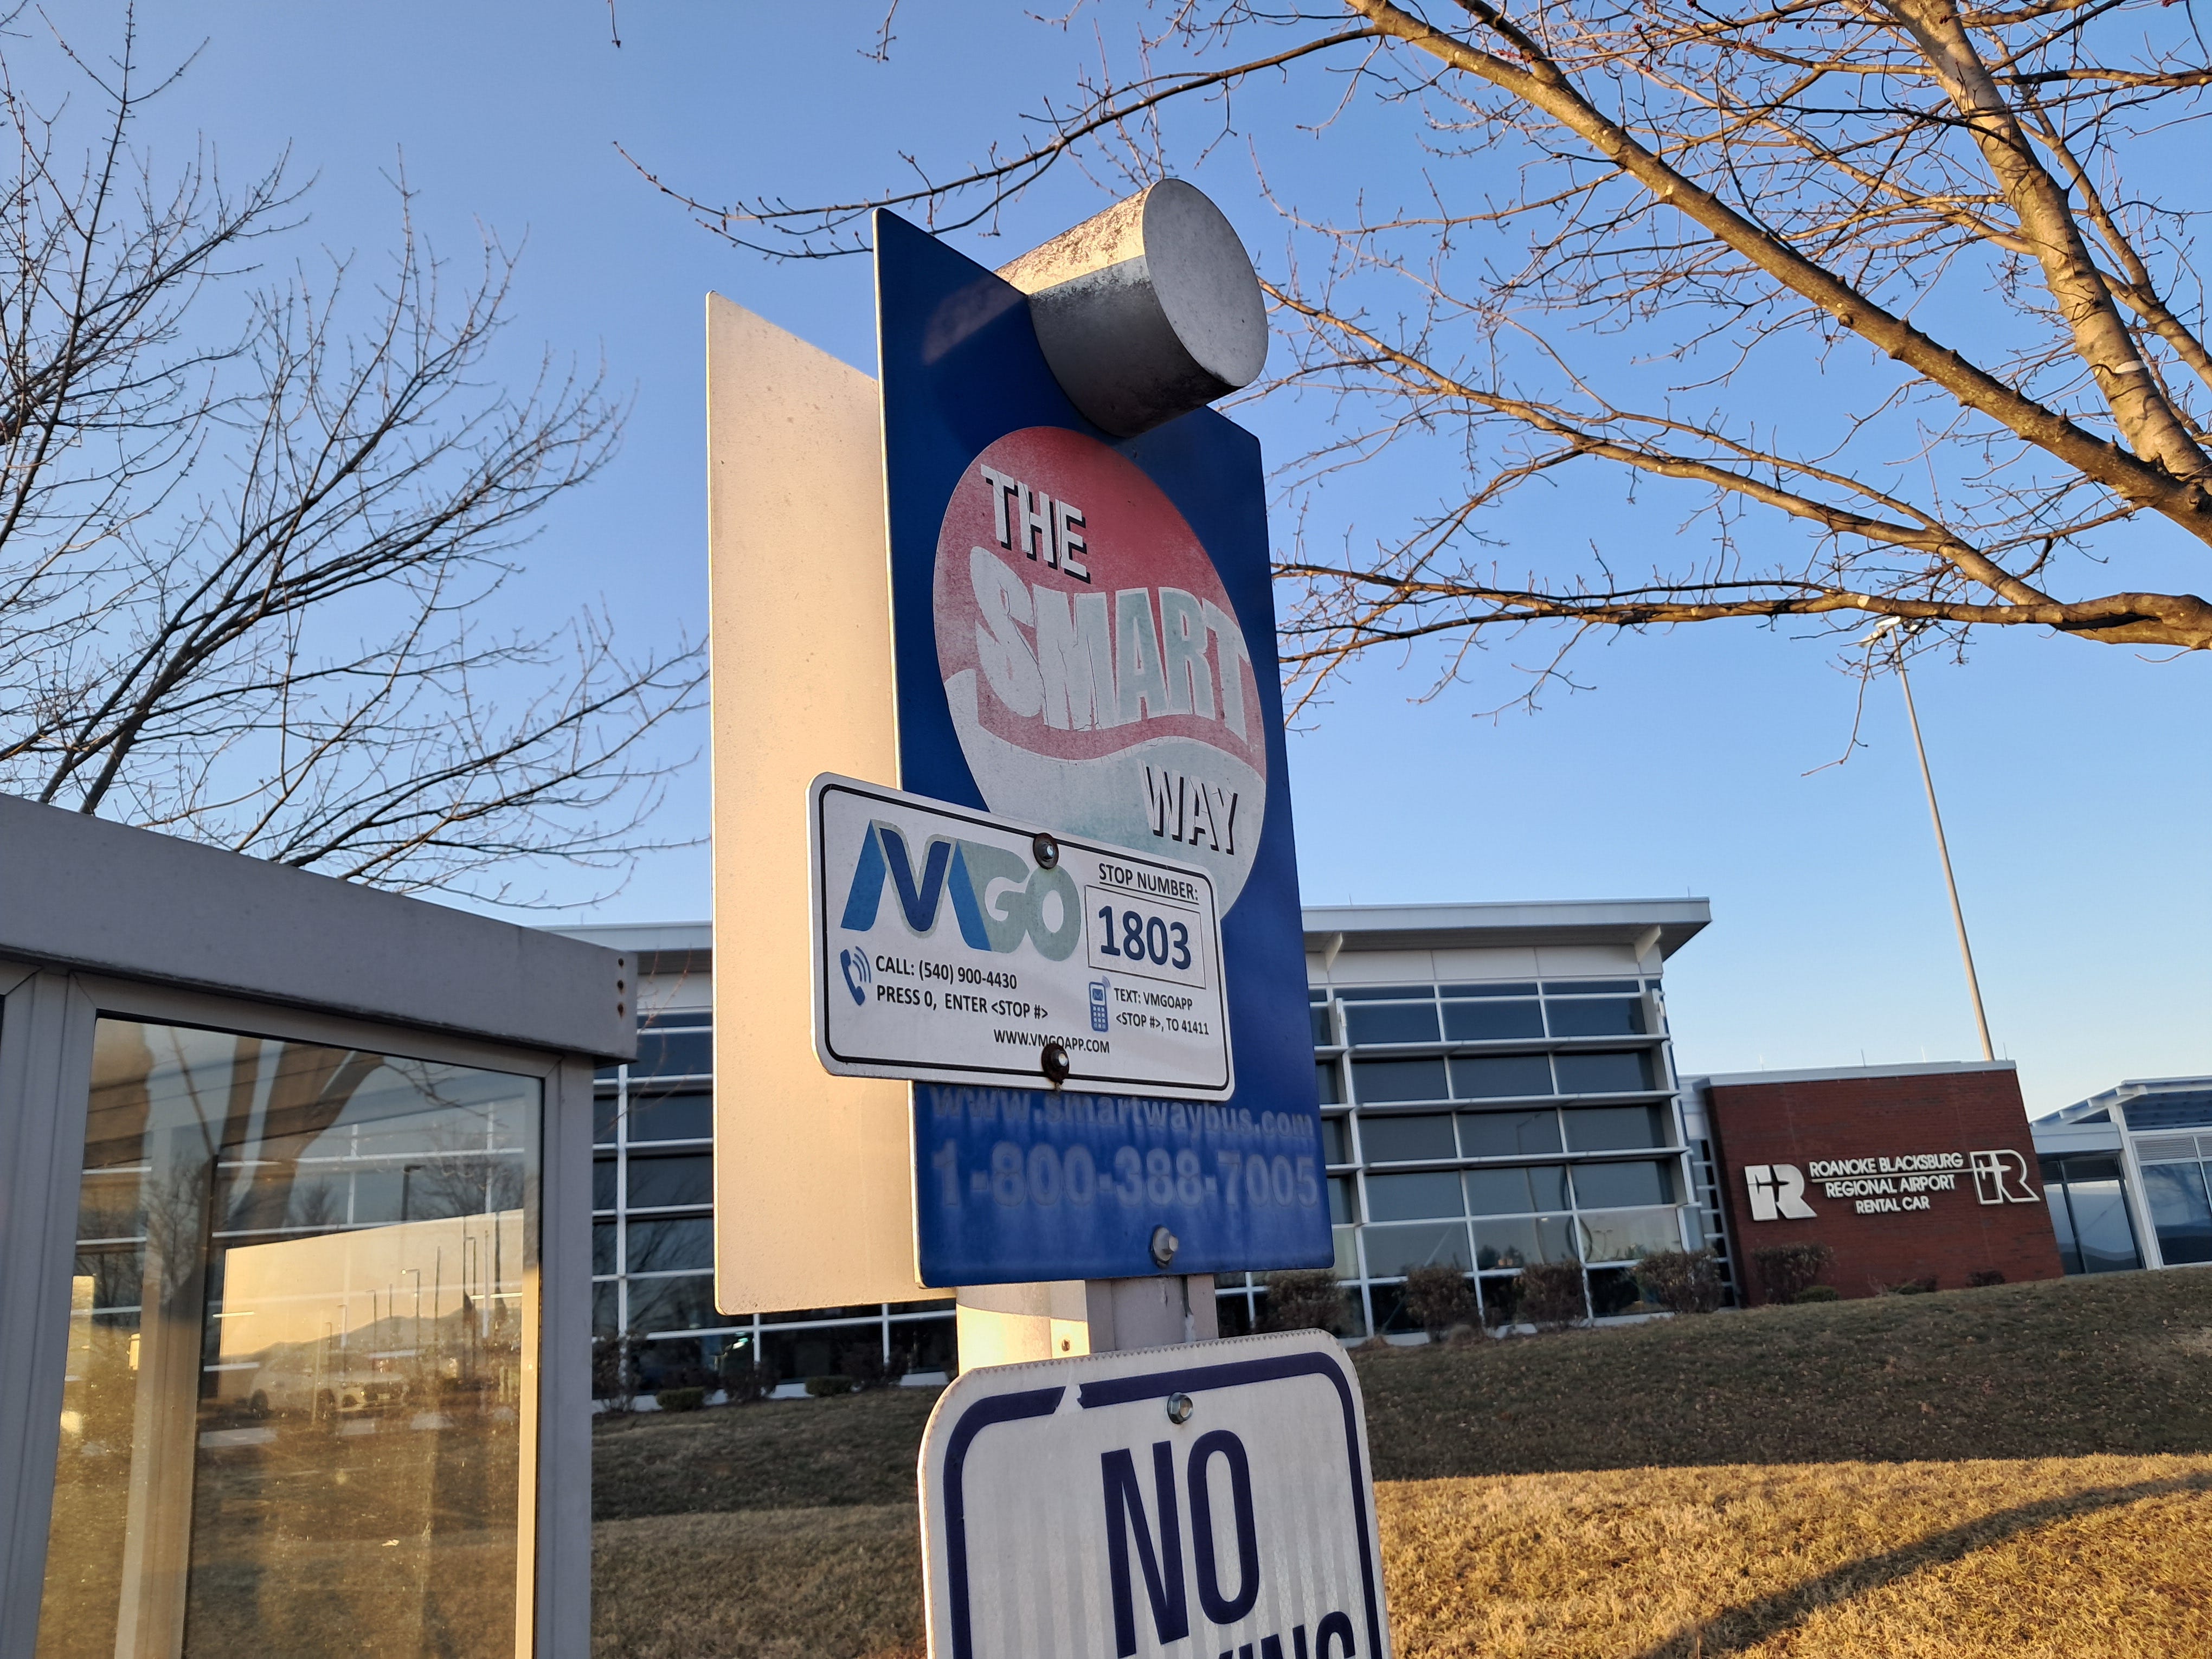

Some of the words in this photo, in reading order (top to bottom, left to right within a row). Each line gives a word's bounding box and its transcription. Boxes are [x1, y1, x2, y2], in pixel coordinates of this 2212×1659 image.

[981, 464, 1091, 584] THE
[969, 545, 1251, 744] SMART
[1138, 759, 1238, 855] WAY
[1098, 862, 1133, 885] STOP
[1137, 871, 1199, 901] NUMBER:
[1098, 905, 1191, 970] 1803
[876, 955, 915, 976] CALL:
[919, 960, 954, 985] (540)
[957, 967, 1017, 989] 900-4430
[877, 985, 921, 1006] PRESS
[945, 993, 988, 1013] ENTER
[991, 1000, 1030, 1018] <STOP
[1034, 1004, 1049, 1020] #>
[1114, 987, 1141, 1004] TEXT:
[1143, 991, 1193, 1011] VMGOAPP
[1116, 1012, 1147, 1027] <STOP
[1166, 1017, 1179, 1032] TO
[1181, 1019, 1210, 1036] 41411
[929, 1086, 1314, 1141] www.smartwaybus.com
[931, 1138, 1320, 1207] 1-800-388-7005
[1809, 1157, 1877, 1178] ROANOKE
[1879, 1152, 1964, 1173] BLACKSBURG
[1825, 1178, 1898, 1198] REGIONAL
[1900, 1174, 1955, 1193] AIRPORT
[1855, 1198, 1901, 1214] RENTAL
[1902, 1195, 1930, 1211] CAR
[1101, 1430, 1260, 1658] NO
